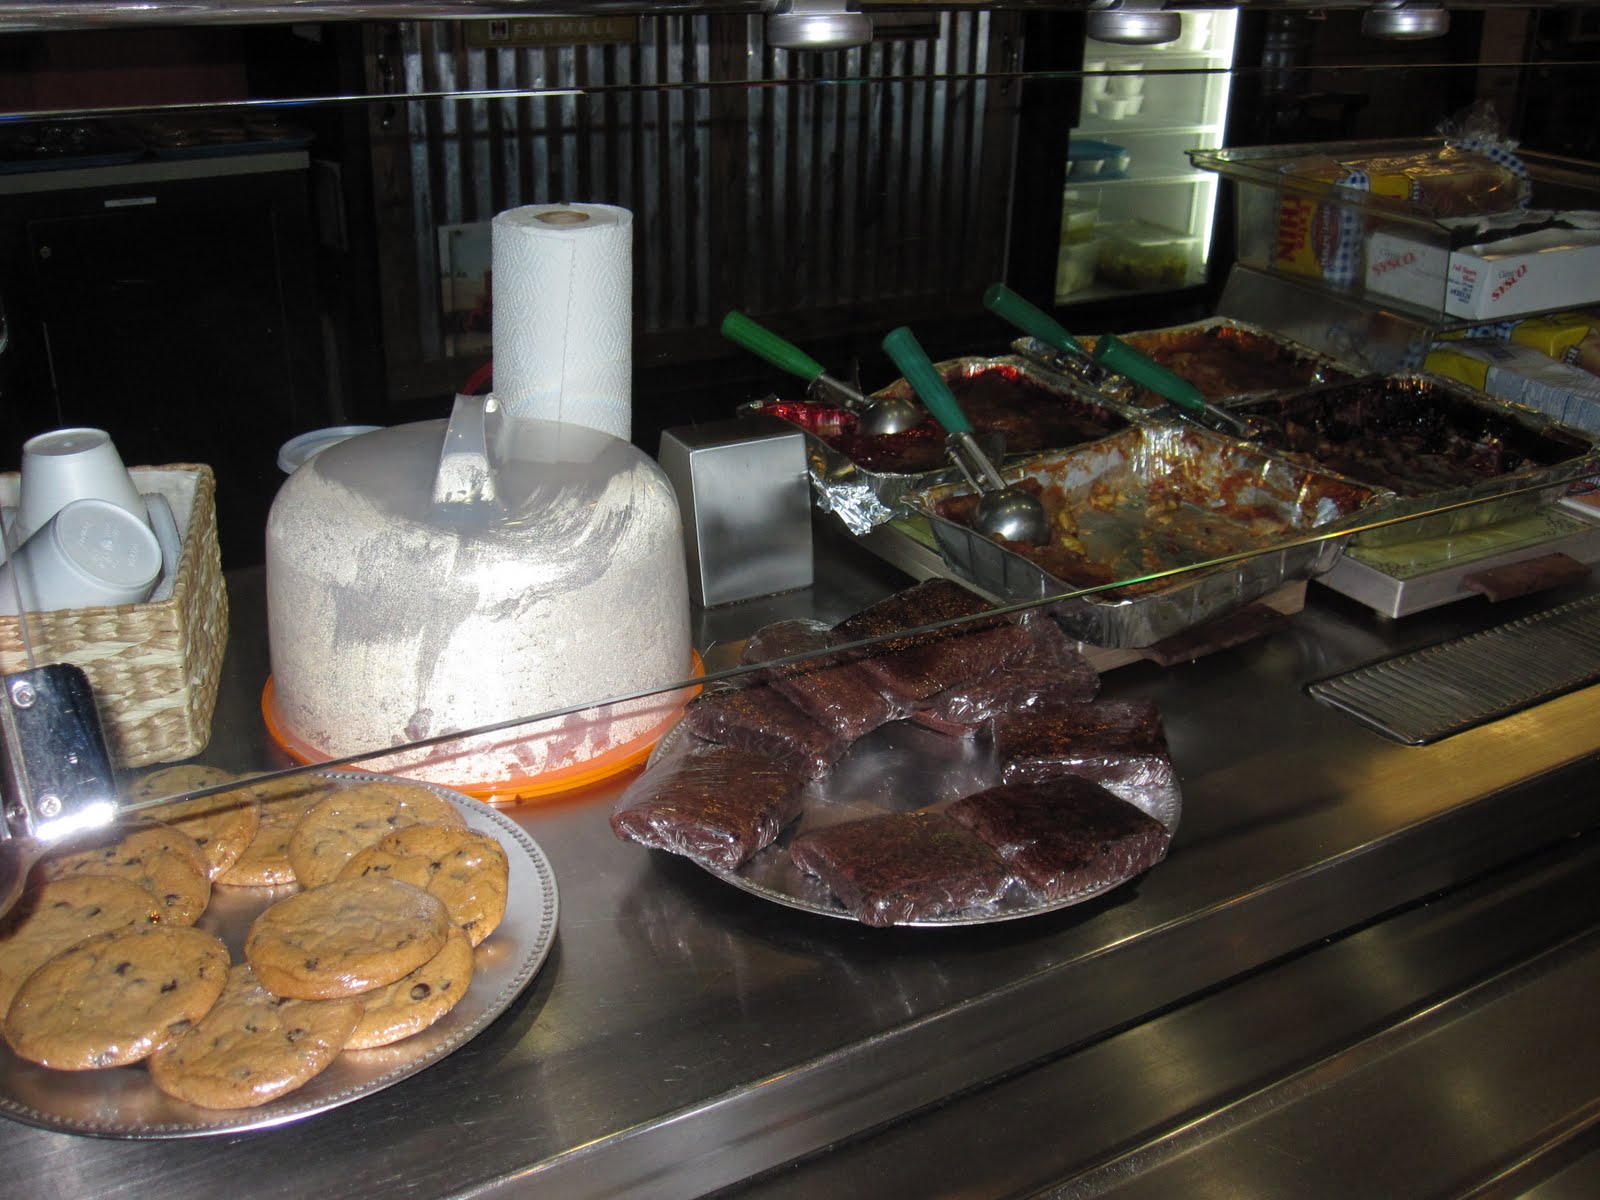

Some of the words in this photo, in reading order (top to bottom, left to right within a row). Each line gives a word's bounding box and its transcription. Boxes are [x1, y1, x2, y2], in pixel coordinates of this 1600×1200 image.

[513, 21, 616, 36] FARMALL
[1372, 253, 1415, 275] SYSCO
[1491, 263, 1528, 301] SYSCO
